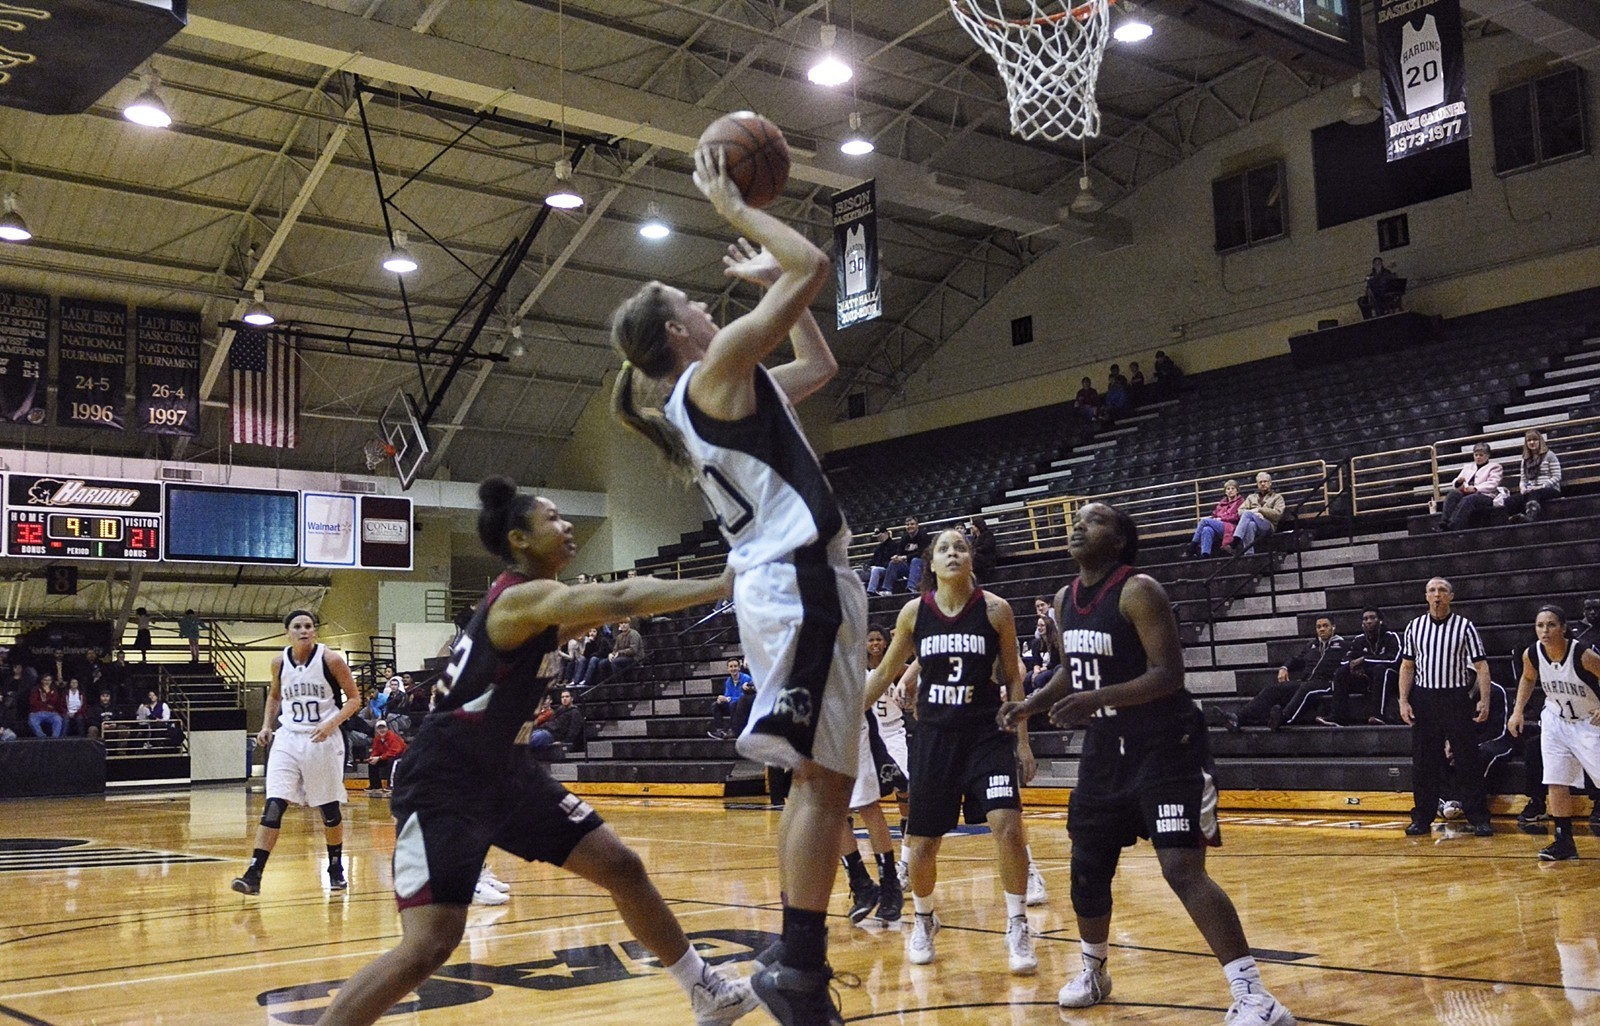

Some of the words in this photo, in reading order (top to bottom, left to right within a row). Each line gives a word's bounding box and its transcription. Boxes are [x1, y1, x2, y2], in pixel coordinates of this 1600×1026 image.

[1403, 40, 1440, 63] HARDING
[1406, 60, 1438, 89] 20
[1393, 119, 1462, 154] 1973-1977
[835, 190, 871, 214] BISON
[849, 256, 865, 275] 30
[61, 306, 89, 322] LADY
[93, 309, 125, 325] BISON
[61, 320, 125, 336] BASKETBALL
[138, 315, 166, 329] LADY
[170, 319, 199, 335] BISON
[62, 335, 125, 351] NATIONAL
[139, 329, 199, 345] BASKETBALL
[61, 349, 125, 365] TOURNAMENT
[140, 342, 199, 357] NATIONAL
[138, 355, 199, 370] TOURNAMENT
[75, 375, 110, 392] 24-5
[151, 384, 185, 400] 26-4
[71, 402, 114, 422] 1996
[149, 407, 187, 426] 1997
[53, 480, 141, 507] HARDING
[10, 512, 45, 523] HOME
[125, 517, 158, 528] VISITOR
[17, 523, 43, 544] 32
[308, 521, 341, 532] Walmart
[367, 522, 403, 534] CONLEY
[131, 528, 156, 548] 21
[21, 545, 46, 554] BONUS
[66, 547, 90, 556] PERIOD
[124, 549, 147, 558] BONUS
[921, 633, 986, 657] HENDERSON
[1063, 629, 1114, 657] ENDERSON
[947, 656, 963, 682] 3
[1070, 657, 1101, 690] 24
[928, 684, 975, 705] STATE
[292, 700, 320, 723] 00
[876, 700, 888, 717] 5
[1555, 699, 1579, 720] 11
[989, 774, 1010, 787] LADY
[986, 786, 1013, 800] REDDIES
[1158, 804, 1184, 818] LADY
[1156, 818, 1190, 833] REDDIES
